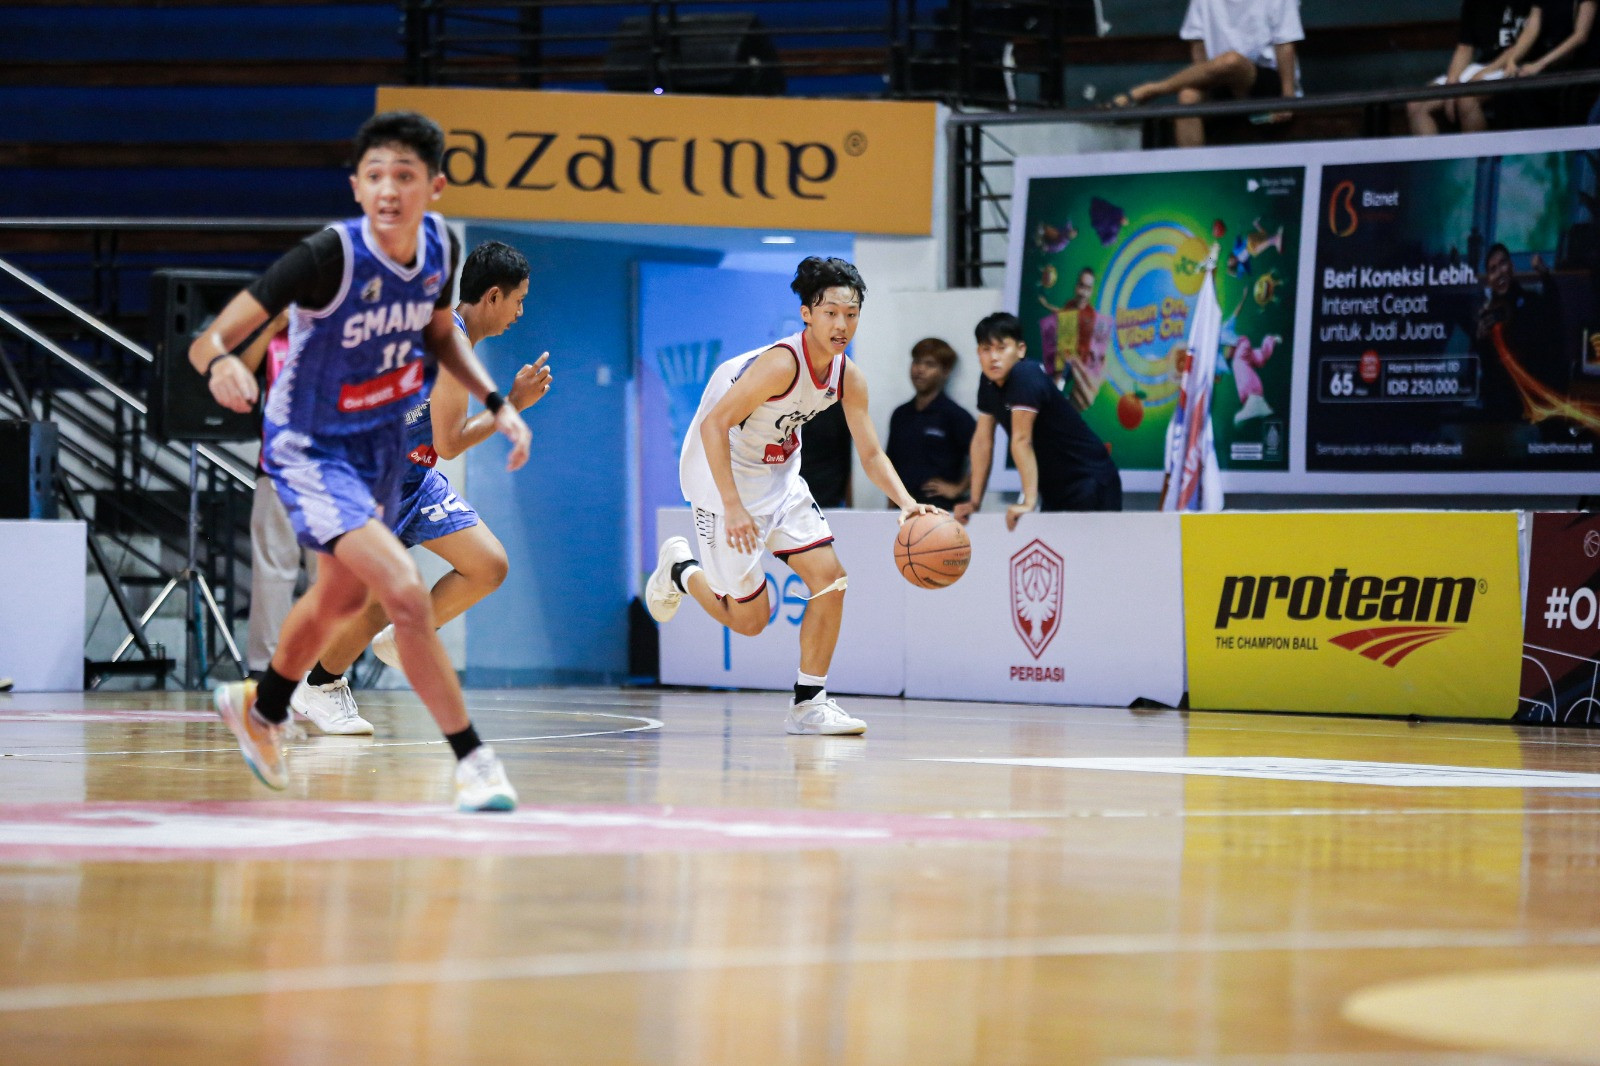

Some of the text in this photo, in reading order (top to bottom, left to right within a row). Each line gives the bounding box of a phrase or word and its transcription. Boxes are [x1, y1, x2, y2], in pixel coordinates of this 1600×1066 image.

[1362, 189, 1399, 207] Biznet
[1323, 262, 1479, 289] Beri Koneksi Lebih.
[1322, 294, 1428, 316] Internet Cepat
[1320, 322, 1362, 342] untuk
[1365, 320, 1397, 341] Jadi
[1330, 372, 1354, 397] 65
[1387, 379, 1409, 396] IDR
[1411, 378, 1459, 398] 250,000
[1214, 568, 1476, 630] proteam
[1543, 586, 1600, 630] #O
[1215, 635, 1319, 651] THE CHAMPION BALL
[1010, 666, 1065, 682] PERBASI
